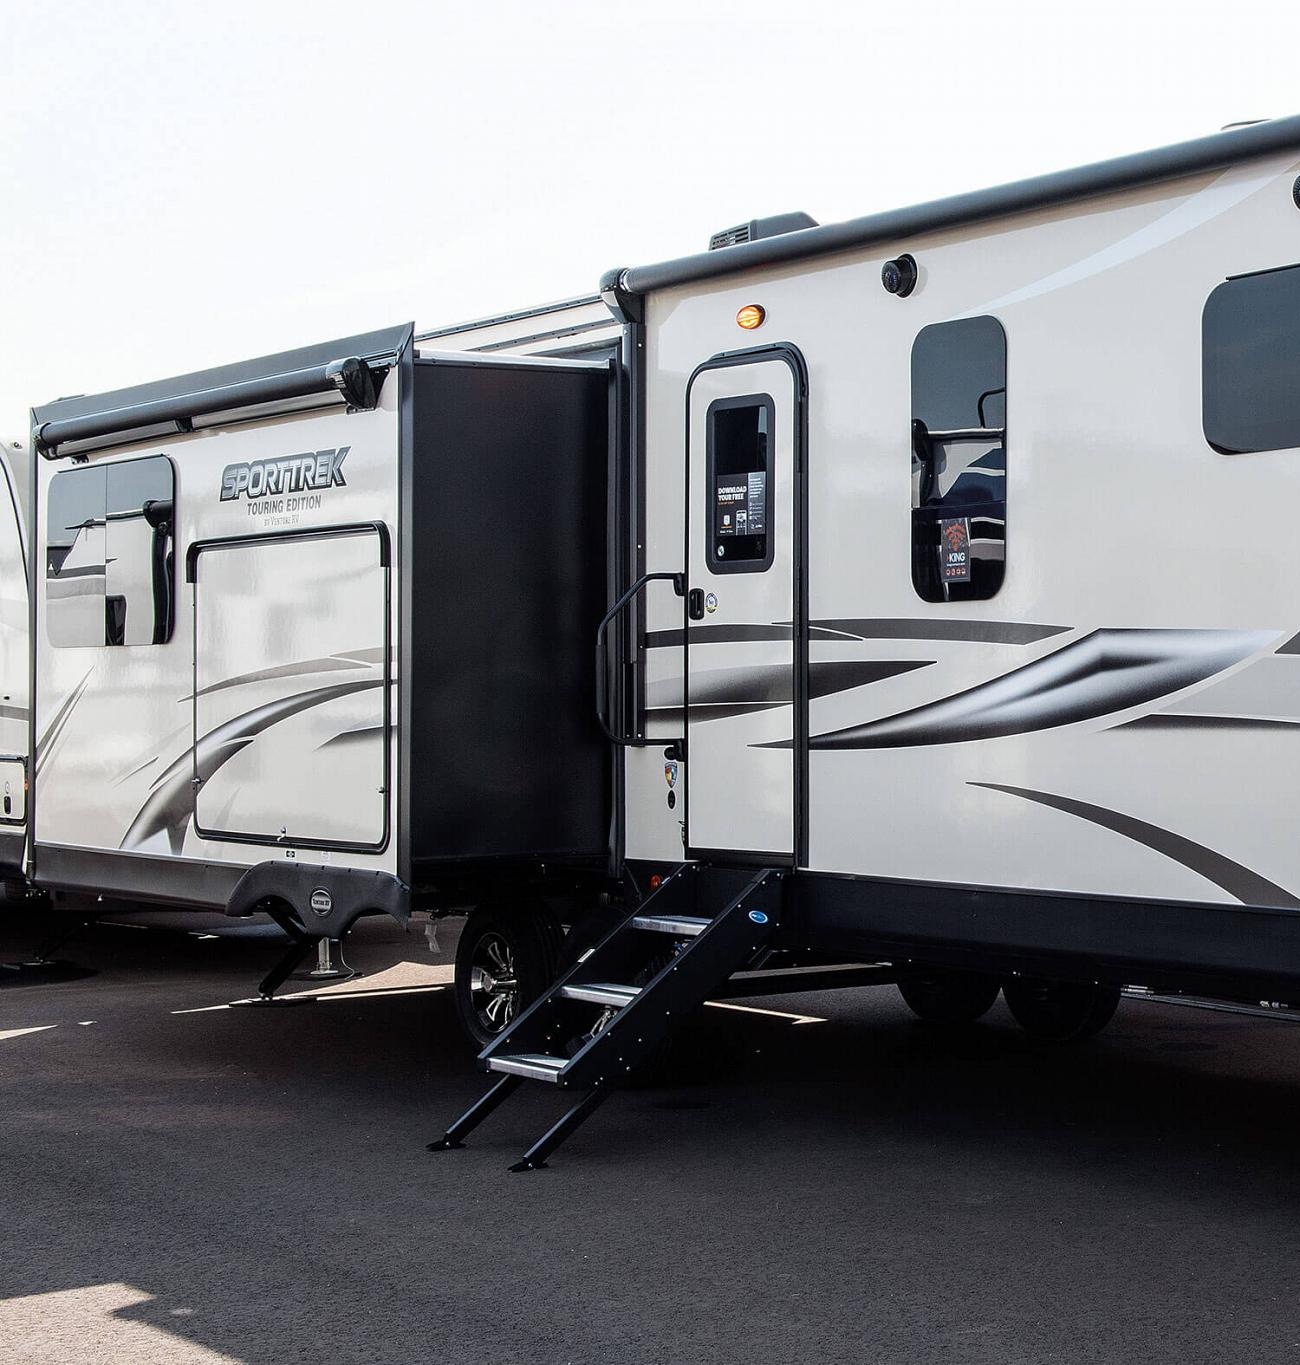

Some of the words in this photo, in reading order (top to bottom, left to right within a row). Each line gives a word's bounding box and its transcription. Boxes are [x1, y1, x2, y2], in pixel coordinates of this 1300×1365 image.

[220, 446, 351, 502] SPORTTREK
[718, 486, 747, 494] DOWNLOAD
[247, 501, 284, 516] TOURING
[286, 495, 322, 512] EDITION
[949, 552, 965, 562] KING
